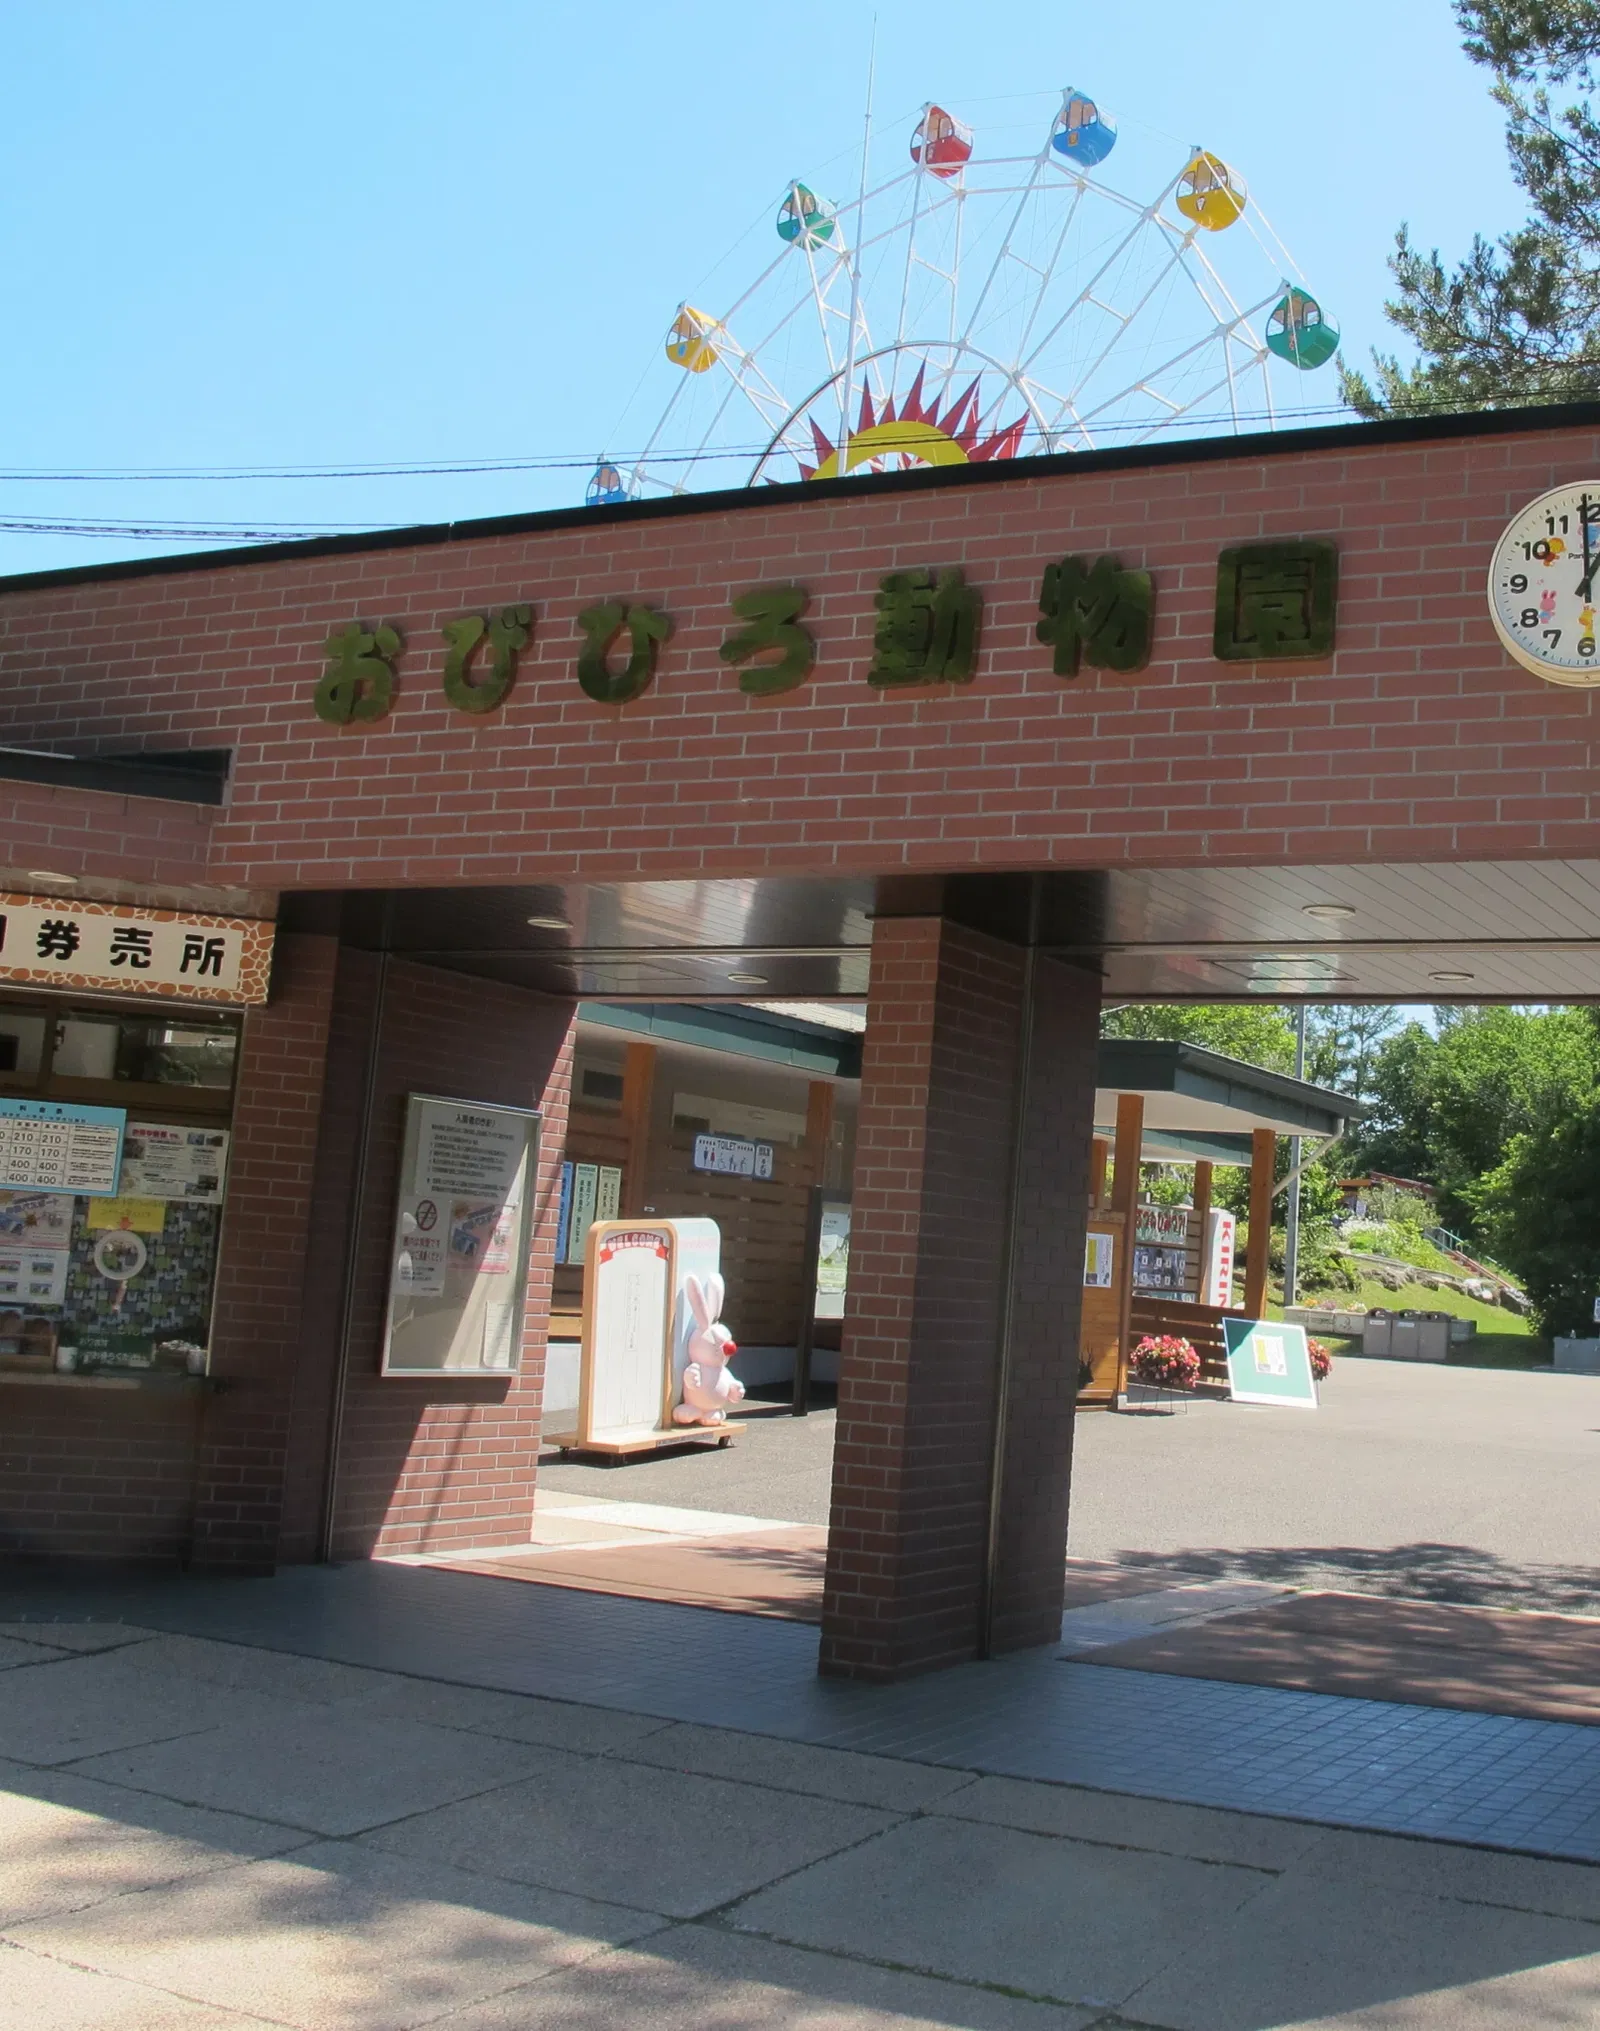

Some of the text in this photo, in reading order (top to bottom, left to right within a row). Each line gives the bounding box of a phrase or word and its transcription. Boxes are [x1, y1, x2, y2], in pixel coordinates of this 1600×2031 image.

[1545, 515, 1569, 535] 11
[1522, 540, 1551, 561] 10
[1510, 573, 1528, 593] 9
[1520, 608, 1539, 628] 8
[314, 541, 1338, 724] おびひろ動物園
[1543, 629, 1562, 649] 7
[1577, 637, 1596, 657] 6
[0, 914, 225, 977] 券売所
[14, 1132, 33, 1142] 210
[42, 1135, 61, 1144] 210
[718, 1140, 737, 1151] TOILET
[13, 1146, 32, 1155] 170
[41, 1148, 59, 1157] 170
[11, 1160, 30, 1169] 400
[39, 1162, 58, 1171] 400
[9, 1173, 28, 1182] 400
[37, 1175, 56, 1184] 400
[607, 1233, 662, 1251] WELCOME
[1218, 1221, 1232, 1307] KIRIN
